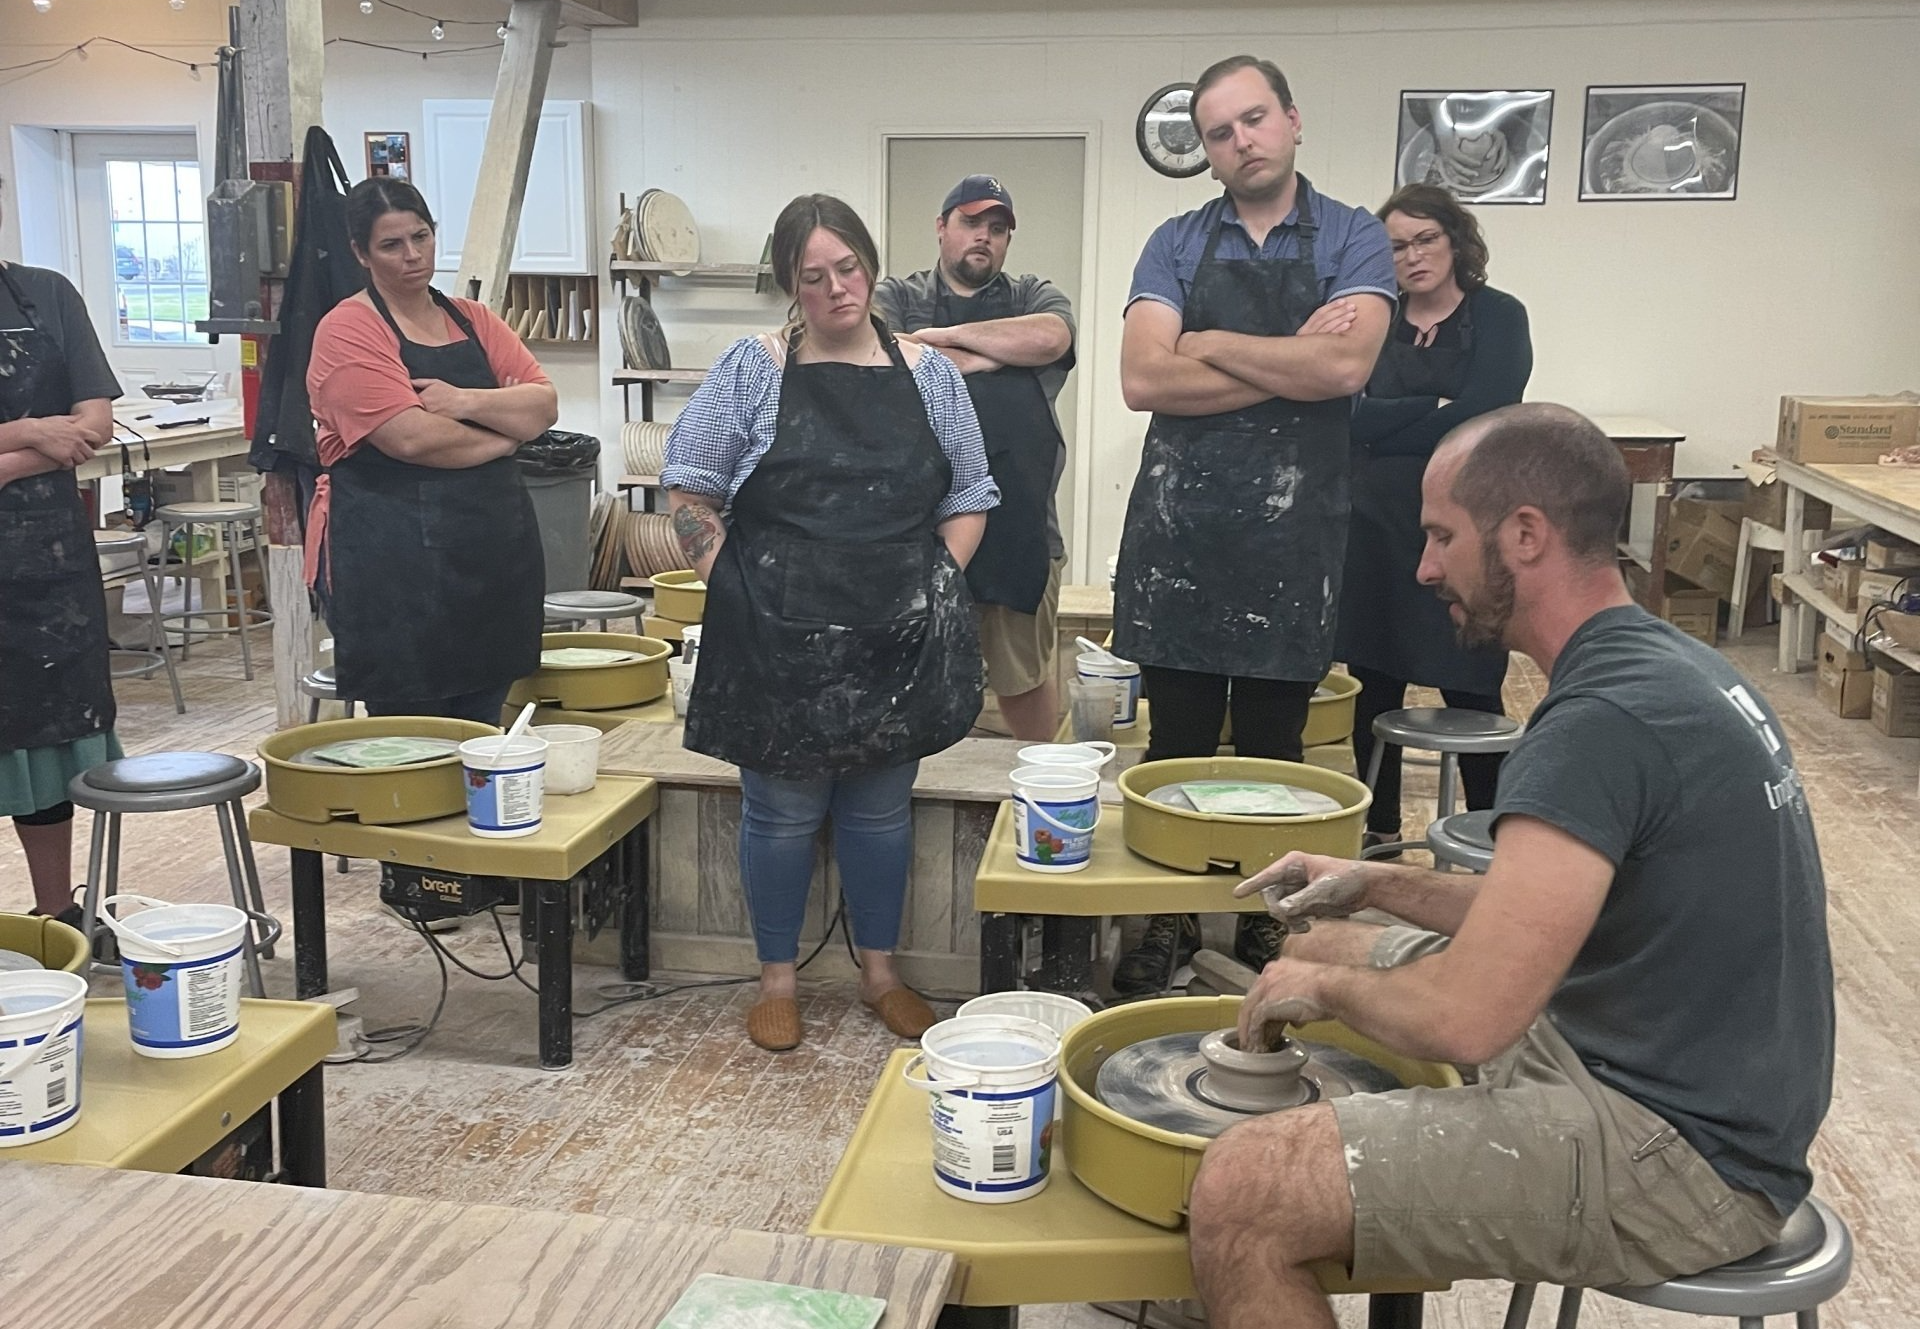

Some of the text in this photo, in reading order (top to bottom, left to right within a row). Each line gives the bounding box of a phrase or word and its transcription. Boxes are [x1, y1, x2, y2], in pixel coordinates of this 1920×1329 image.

[1839, 424, 1892, 434] Standard
[422, 876, 462, 895] brent
[997, 1129, 1013, 1137] USA
